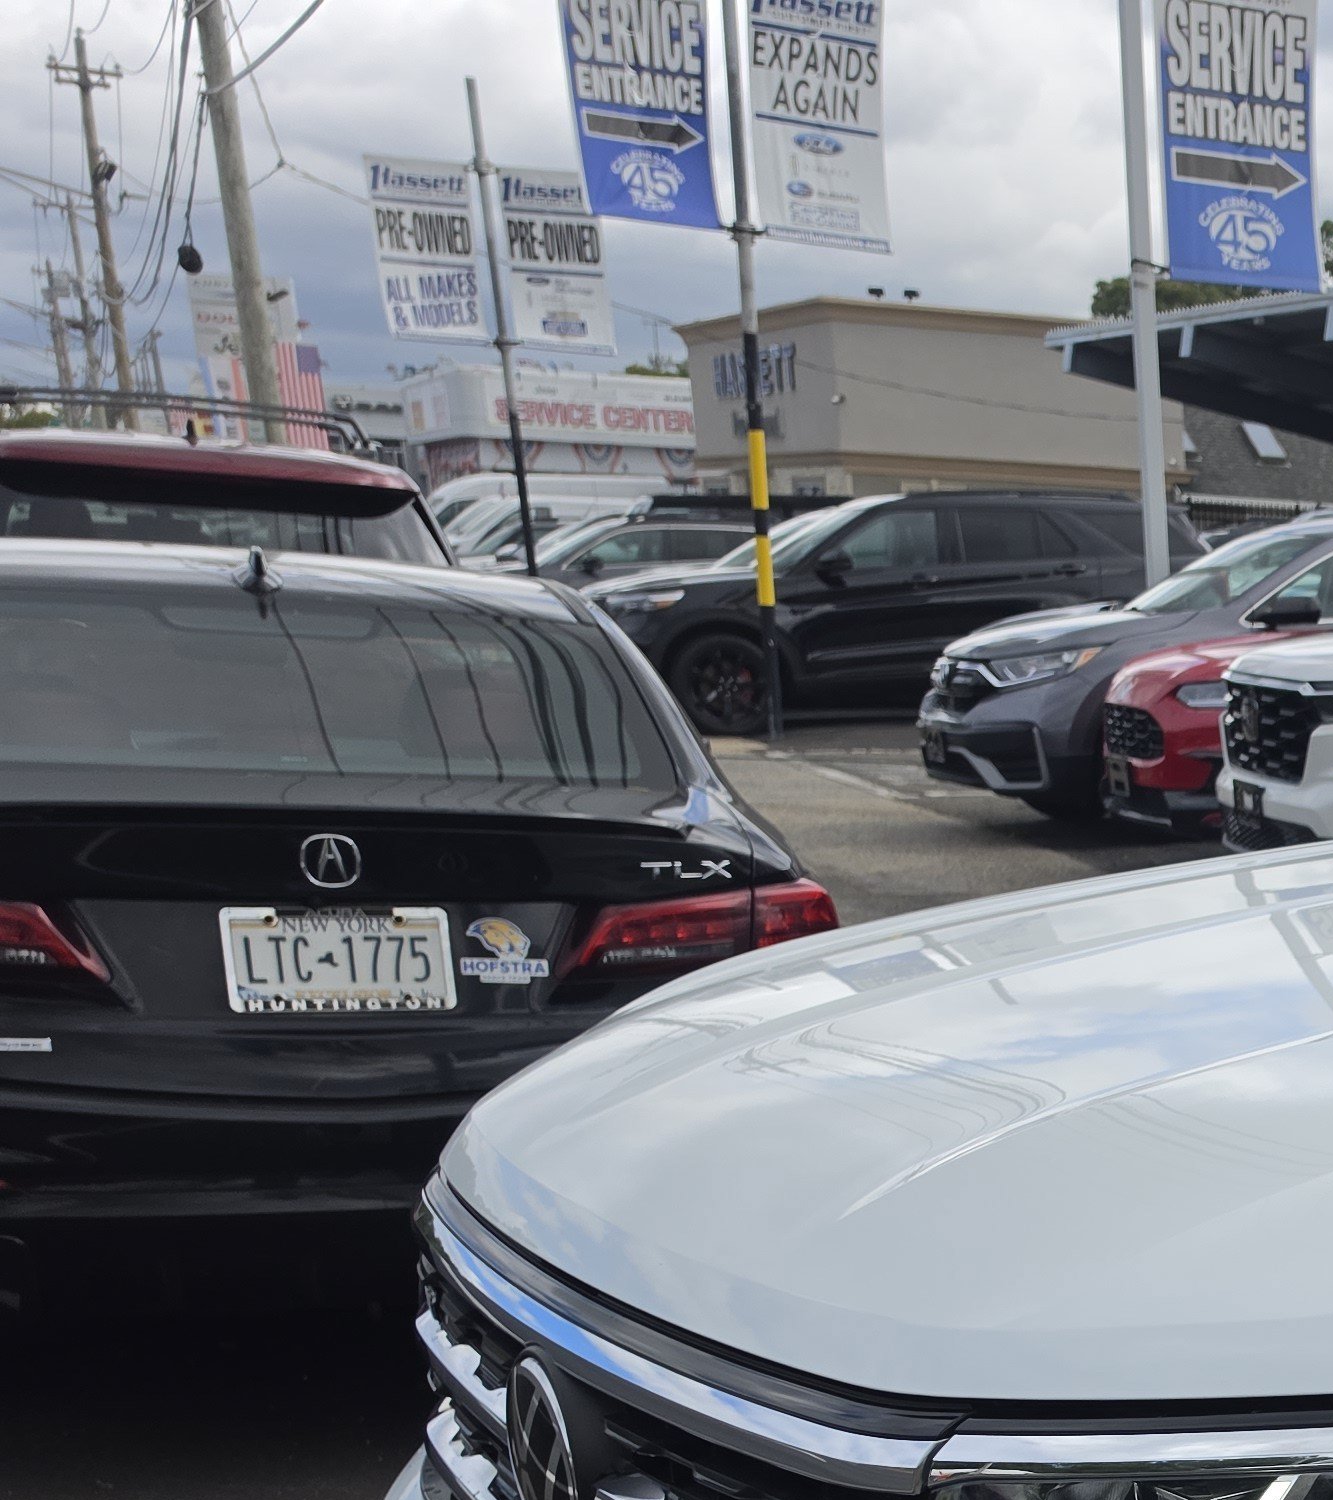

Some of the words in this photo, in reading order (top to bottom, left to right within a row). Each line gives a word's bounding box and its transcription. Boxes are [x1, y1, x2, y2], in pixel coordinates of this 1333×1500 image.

[570, 0, 702, 76] SERVICE
[752, 30, 879, 87] EXPANDS
[1165, 0, 1308, 104] SERVICE
[574, 61, 704, 115] ENTRANCE
[773, 77, 860, 122] AGAIN
[1167, 90, 1308, 152] ENTRANCE
[375, 207, 472, 256] PRE-OWNED
[1199, 195, 1285, 236] CELEBRATING
[1213, 212, 1271, 255] 45
[506, 219, 600, 265] PRE-OWNED
[1221, 253, 1272, 272] YEARS
[387, 277, 414, 302] ALL
[418, 272, 478, 299] MAKES
[412, 301, 479, 329] MODELS
[603, 405, 694, 433] CENTER
[640, 860, 733, 880] TLX
[281, 916, 330, 934] NEW
[334, 916, 391, 934] YORK
[243, 935, 313, 984] LTC
[341, 935, 432, 984] 1775
[463, 960, 546, 974] HOFSTRA
